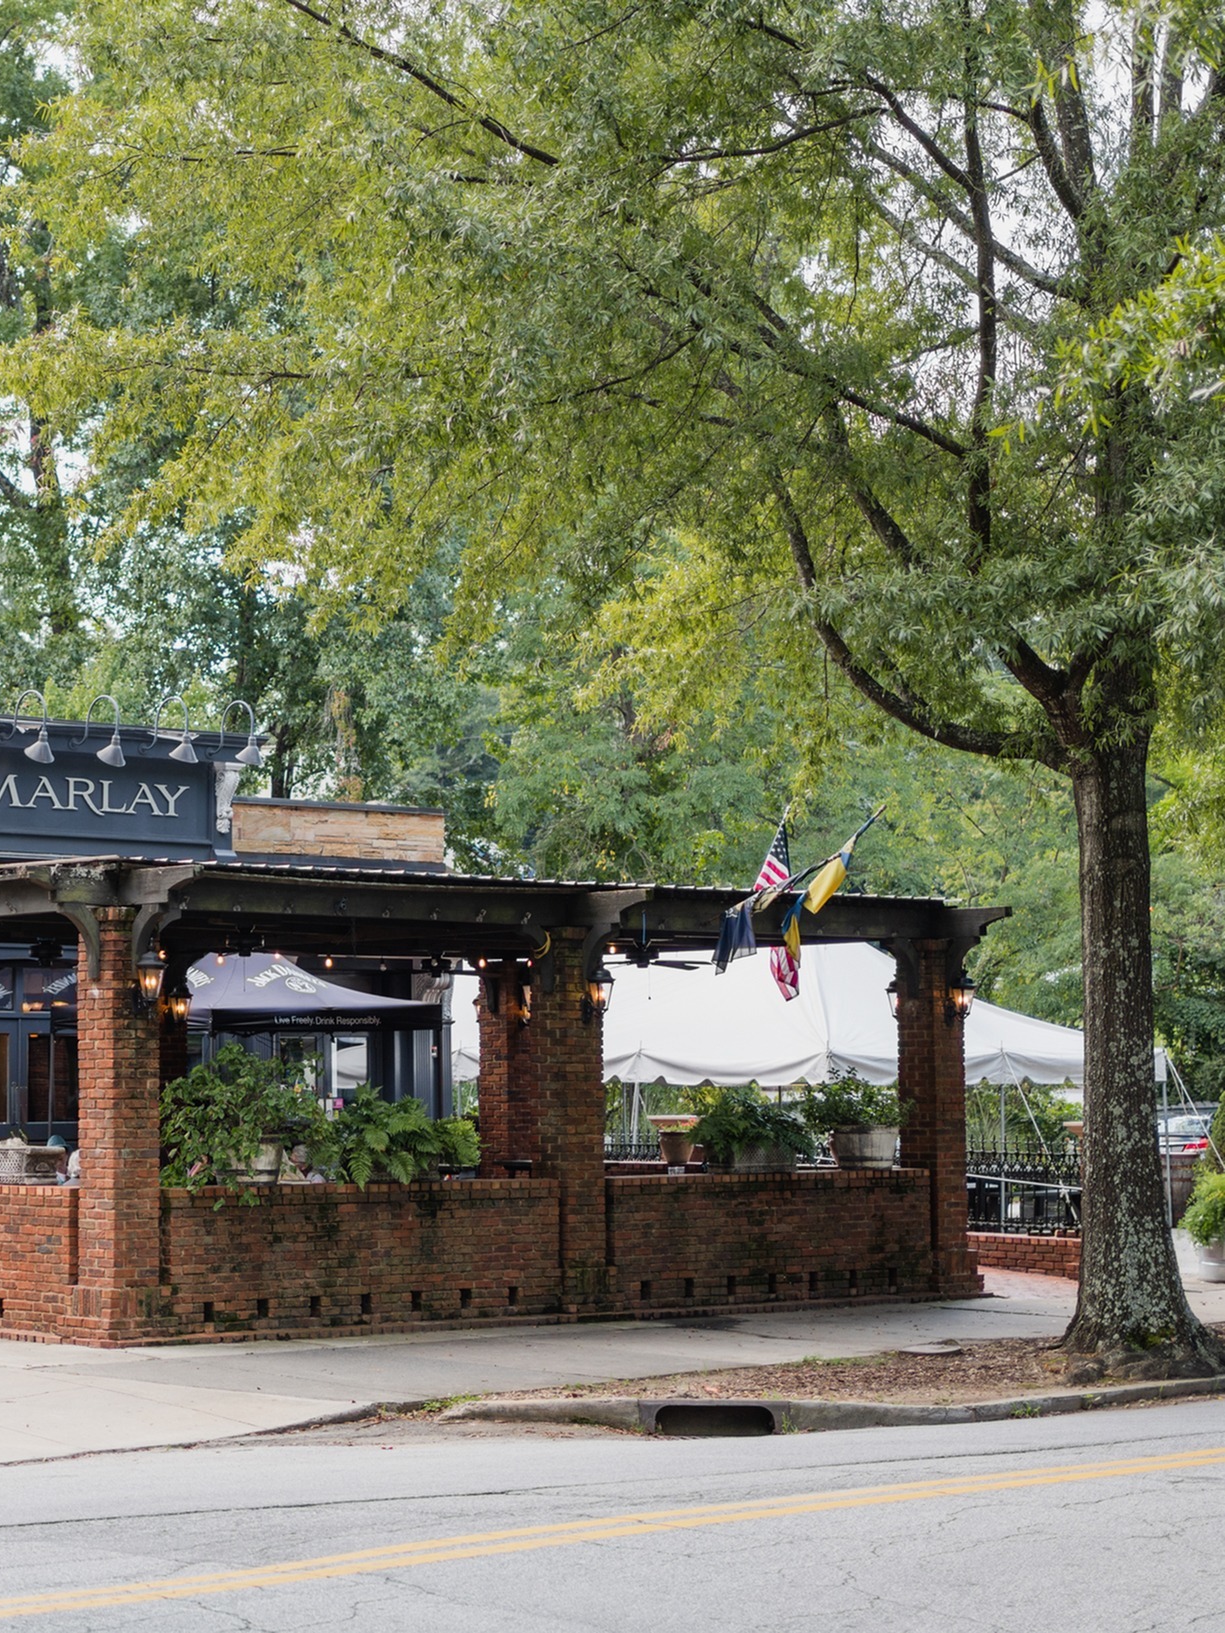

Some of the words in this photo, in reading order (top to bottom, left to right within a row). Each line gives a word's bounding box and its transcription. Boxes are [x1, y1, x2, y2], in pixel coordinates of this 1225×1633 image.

[274, 1015, 290, 1025] Live
[316, 1016, 335, 1025] Drink
[336, 1016, 382, 1026] Responsibly.
